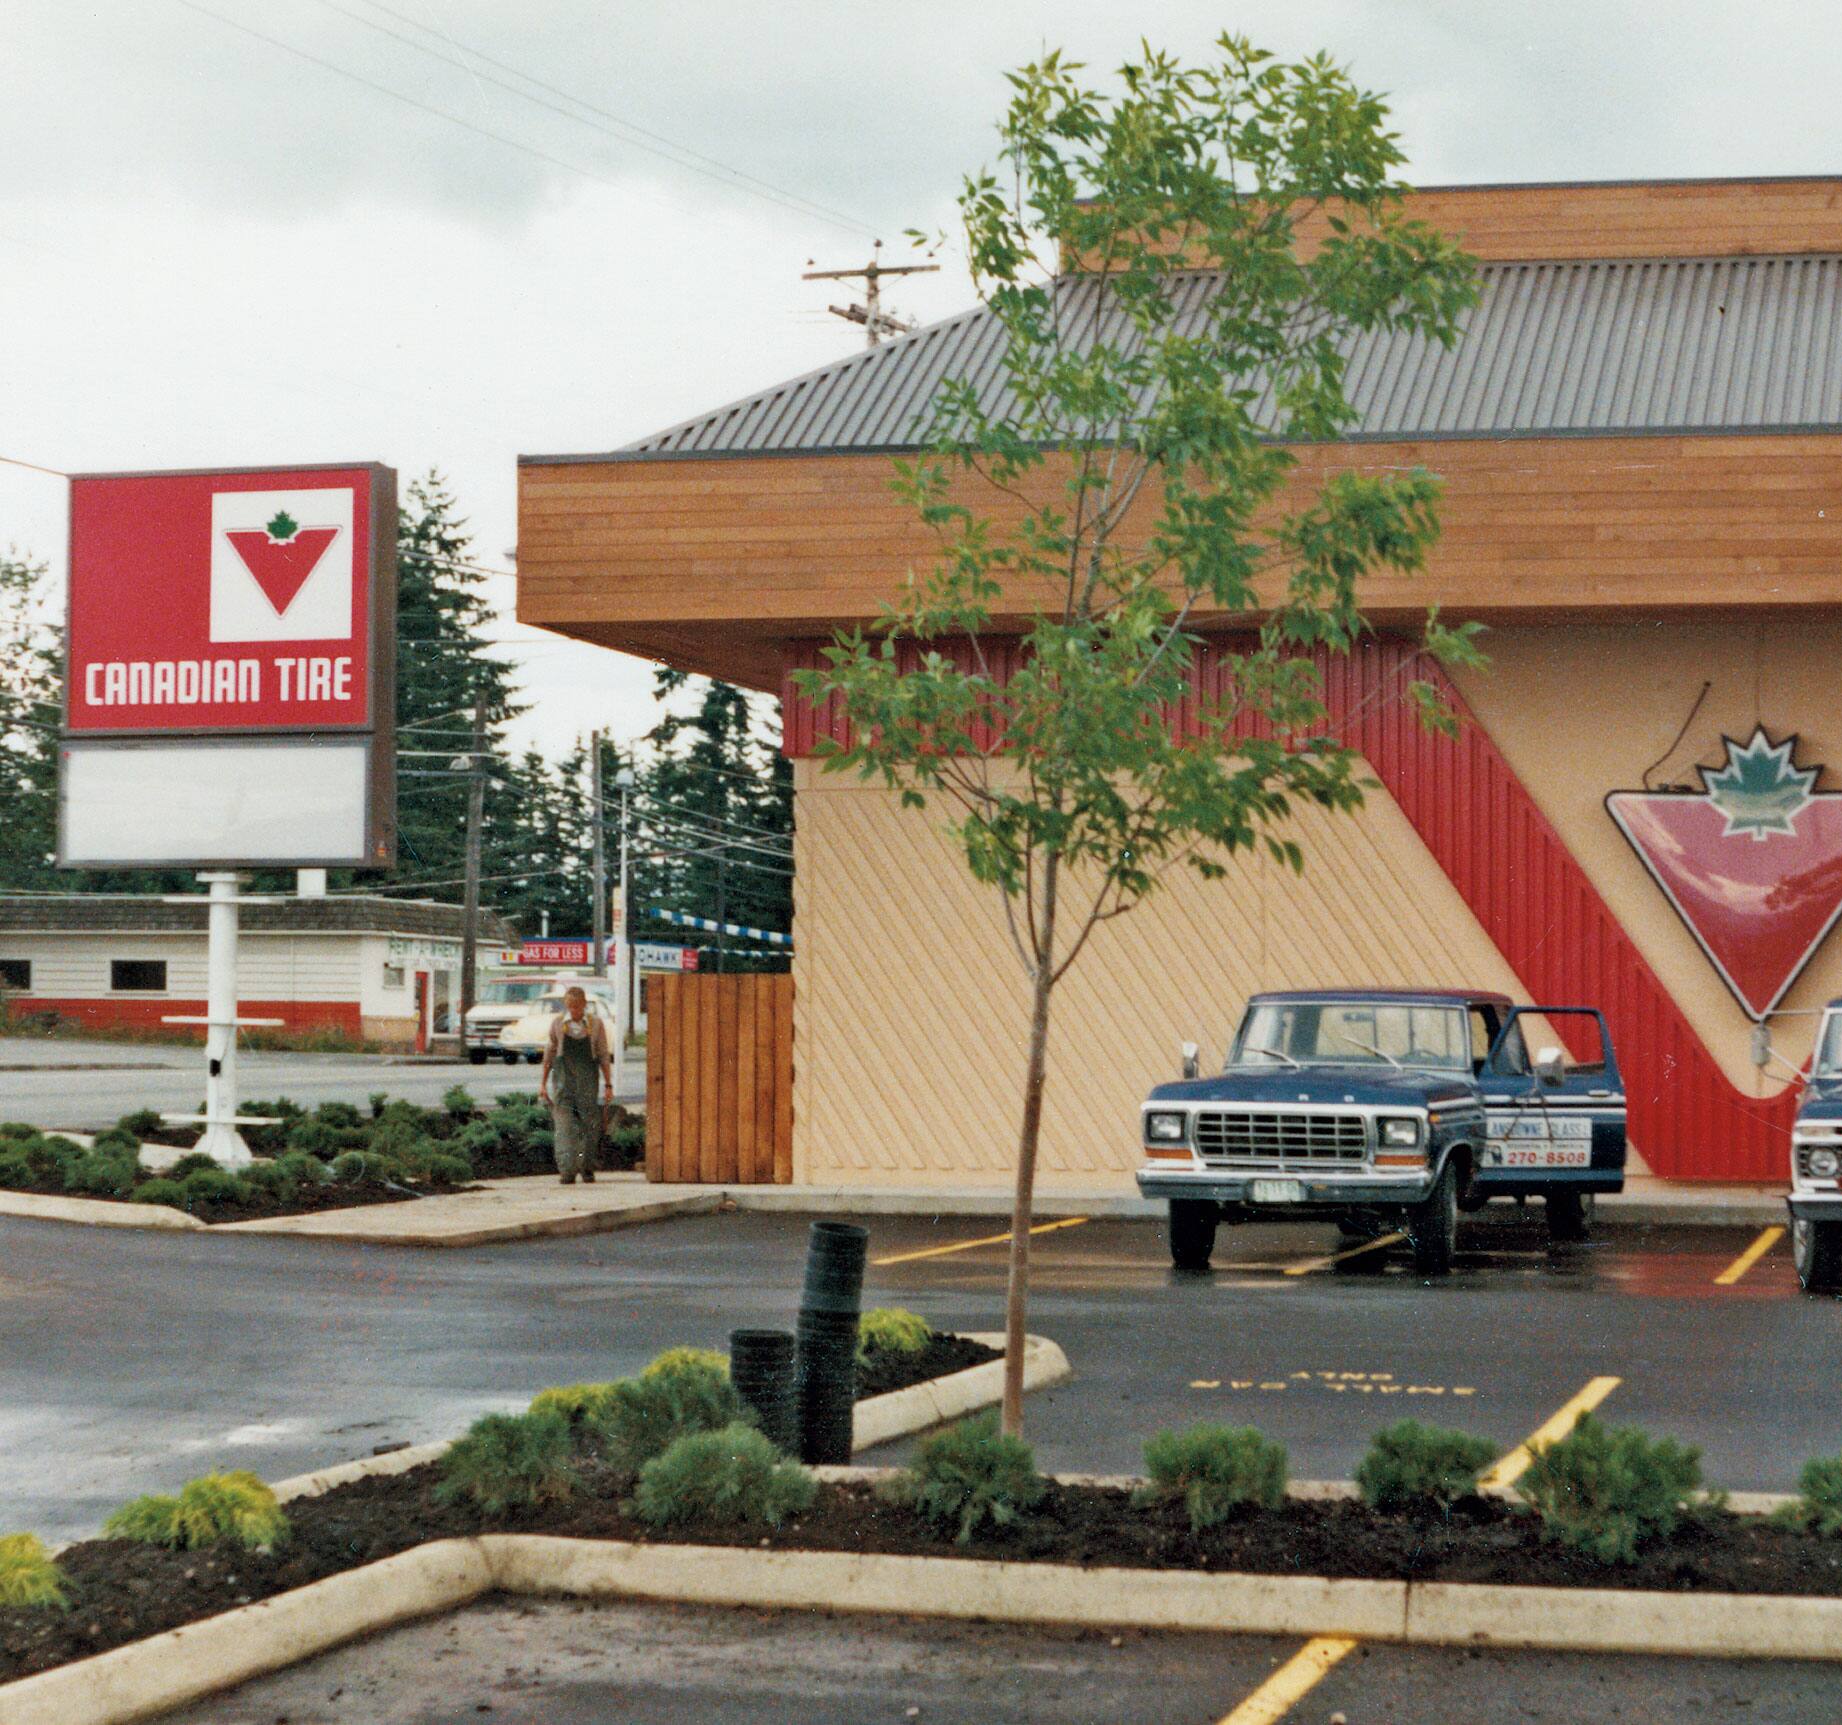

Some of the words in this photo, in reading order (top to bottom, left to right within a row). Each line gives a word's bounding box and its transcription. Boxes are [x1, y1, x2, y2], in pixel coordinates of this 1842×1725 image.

[85, 660, 260, 706] CANADIAN
[275, 656, 352, 702] TIRE
[636, 947, 680, 962] OHAWK
